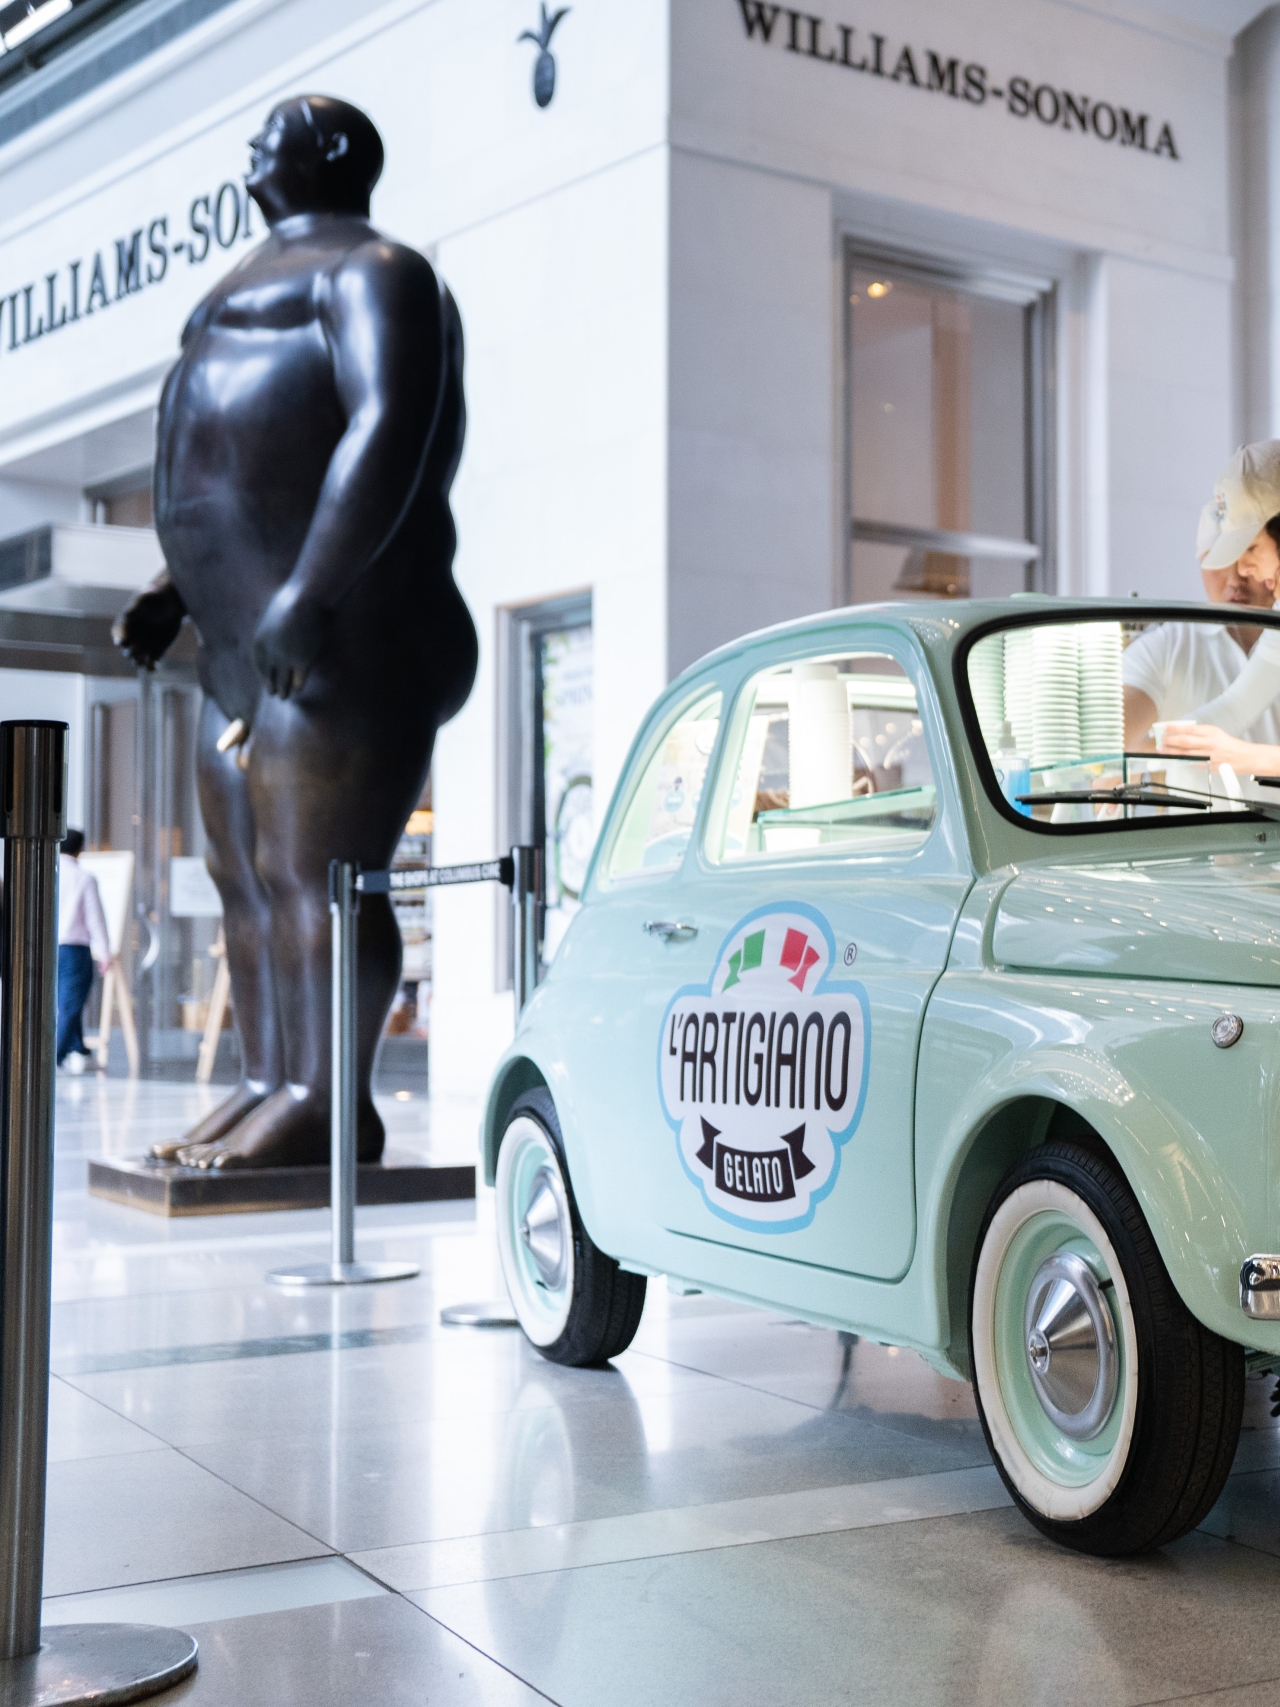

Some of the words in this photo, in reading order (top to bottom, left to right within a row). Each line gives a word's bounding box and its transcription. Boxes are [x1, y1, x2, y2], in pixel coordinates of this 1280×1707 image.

[737, 0, 1180, 161] WILLIAMS-SONOMA
[389, 871, 404, 889] THE
[404, 869, 428, 888] SHOPS
[429, 868, 439, 885] AT
[440, 863, 481, 884] COLUMBUS
[669, 1011, 851, 1111] L'ARTIGIANO
[723, 1151, 784, 1195] GELATO
